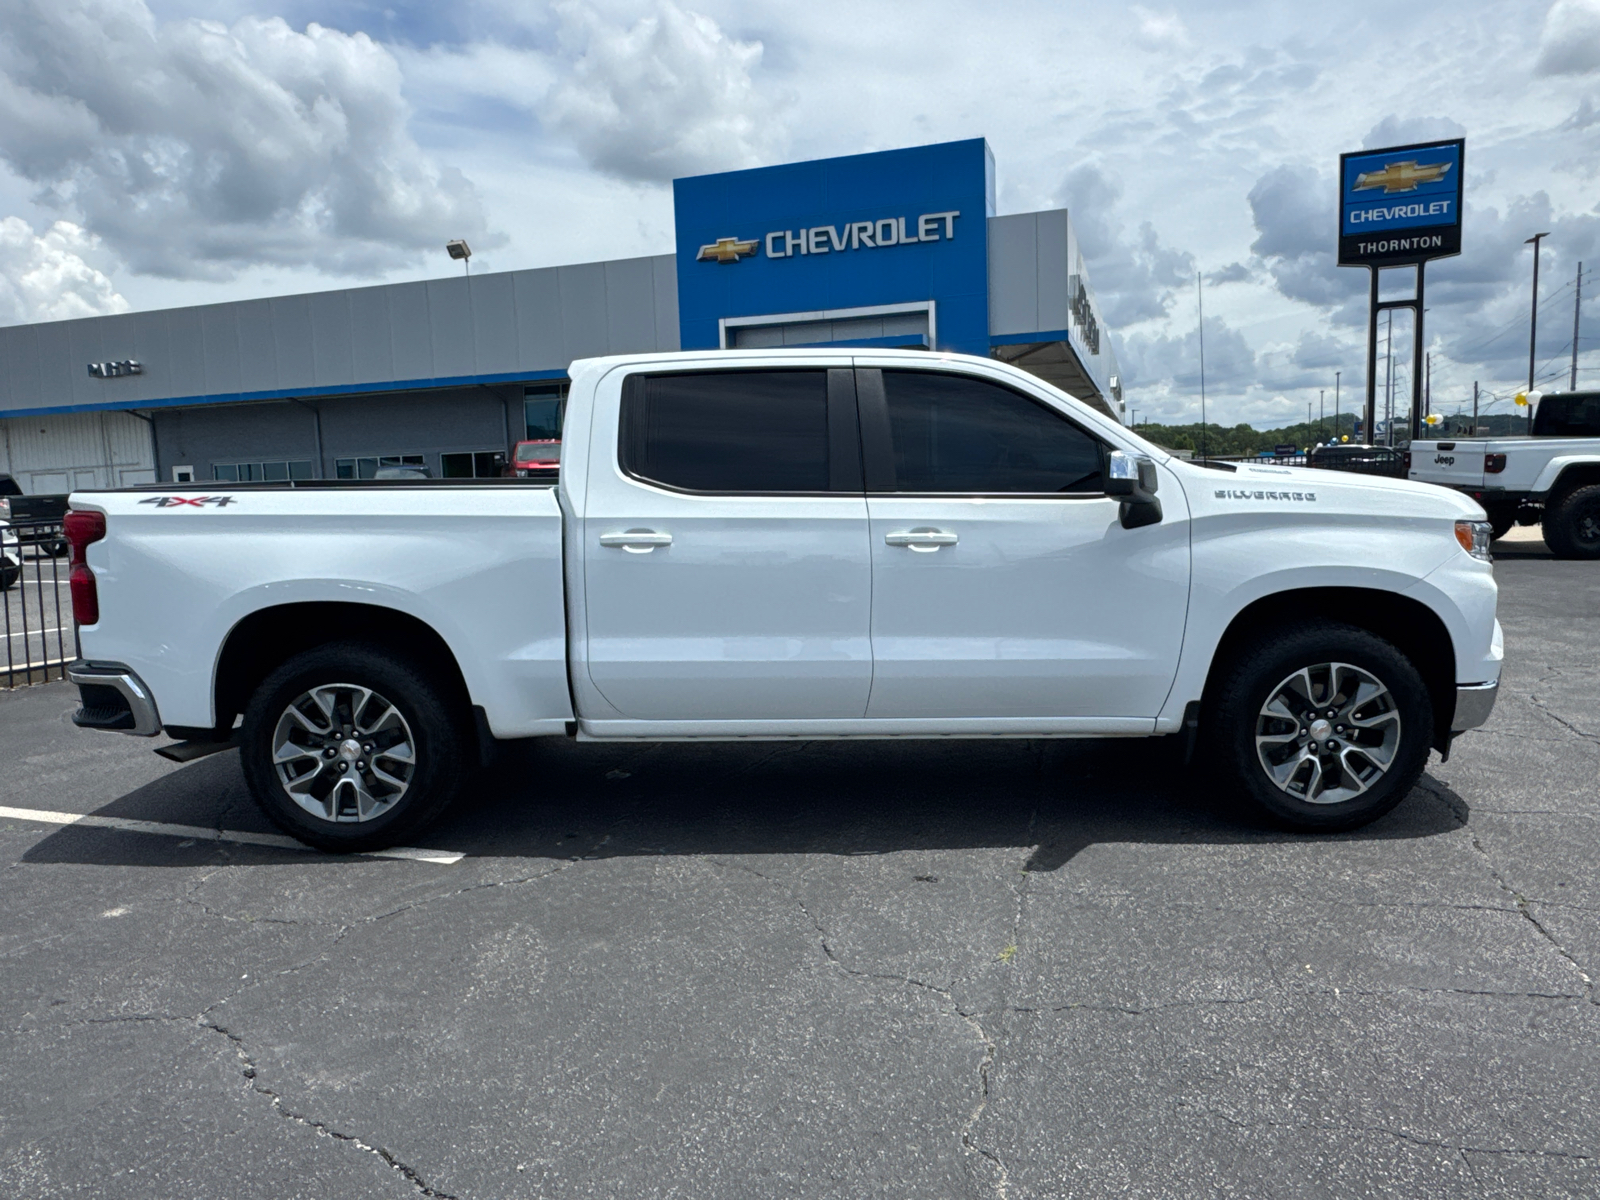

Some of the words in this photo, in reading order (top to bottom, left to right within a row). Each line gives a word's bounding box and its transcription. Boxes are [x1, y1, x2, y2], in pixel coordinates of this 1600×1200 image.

[1350, 200, 1451, 224] CHEVROLET
[765, 211, 960, 258] CHEVROLET
[1358, 235, 1442, 254] THORNTON
[1434, 453, 1455, 466] Jeep
[1214, 489, 1317, 502] SILVERADO
